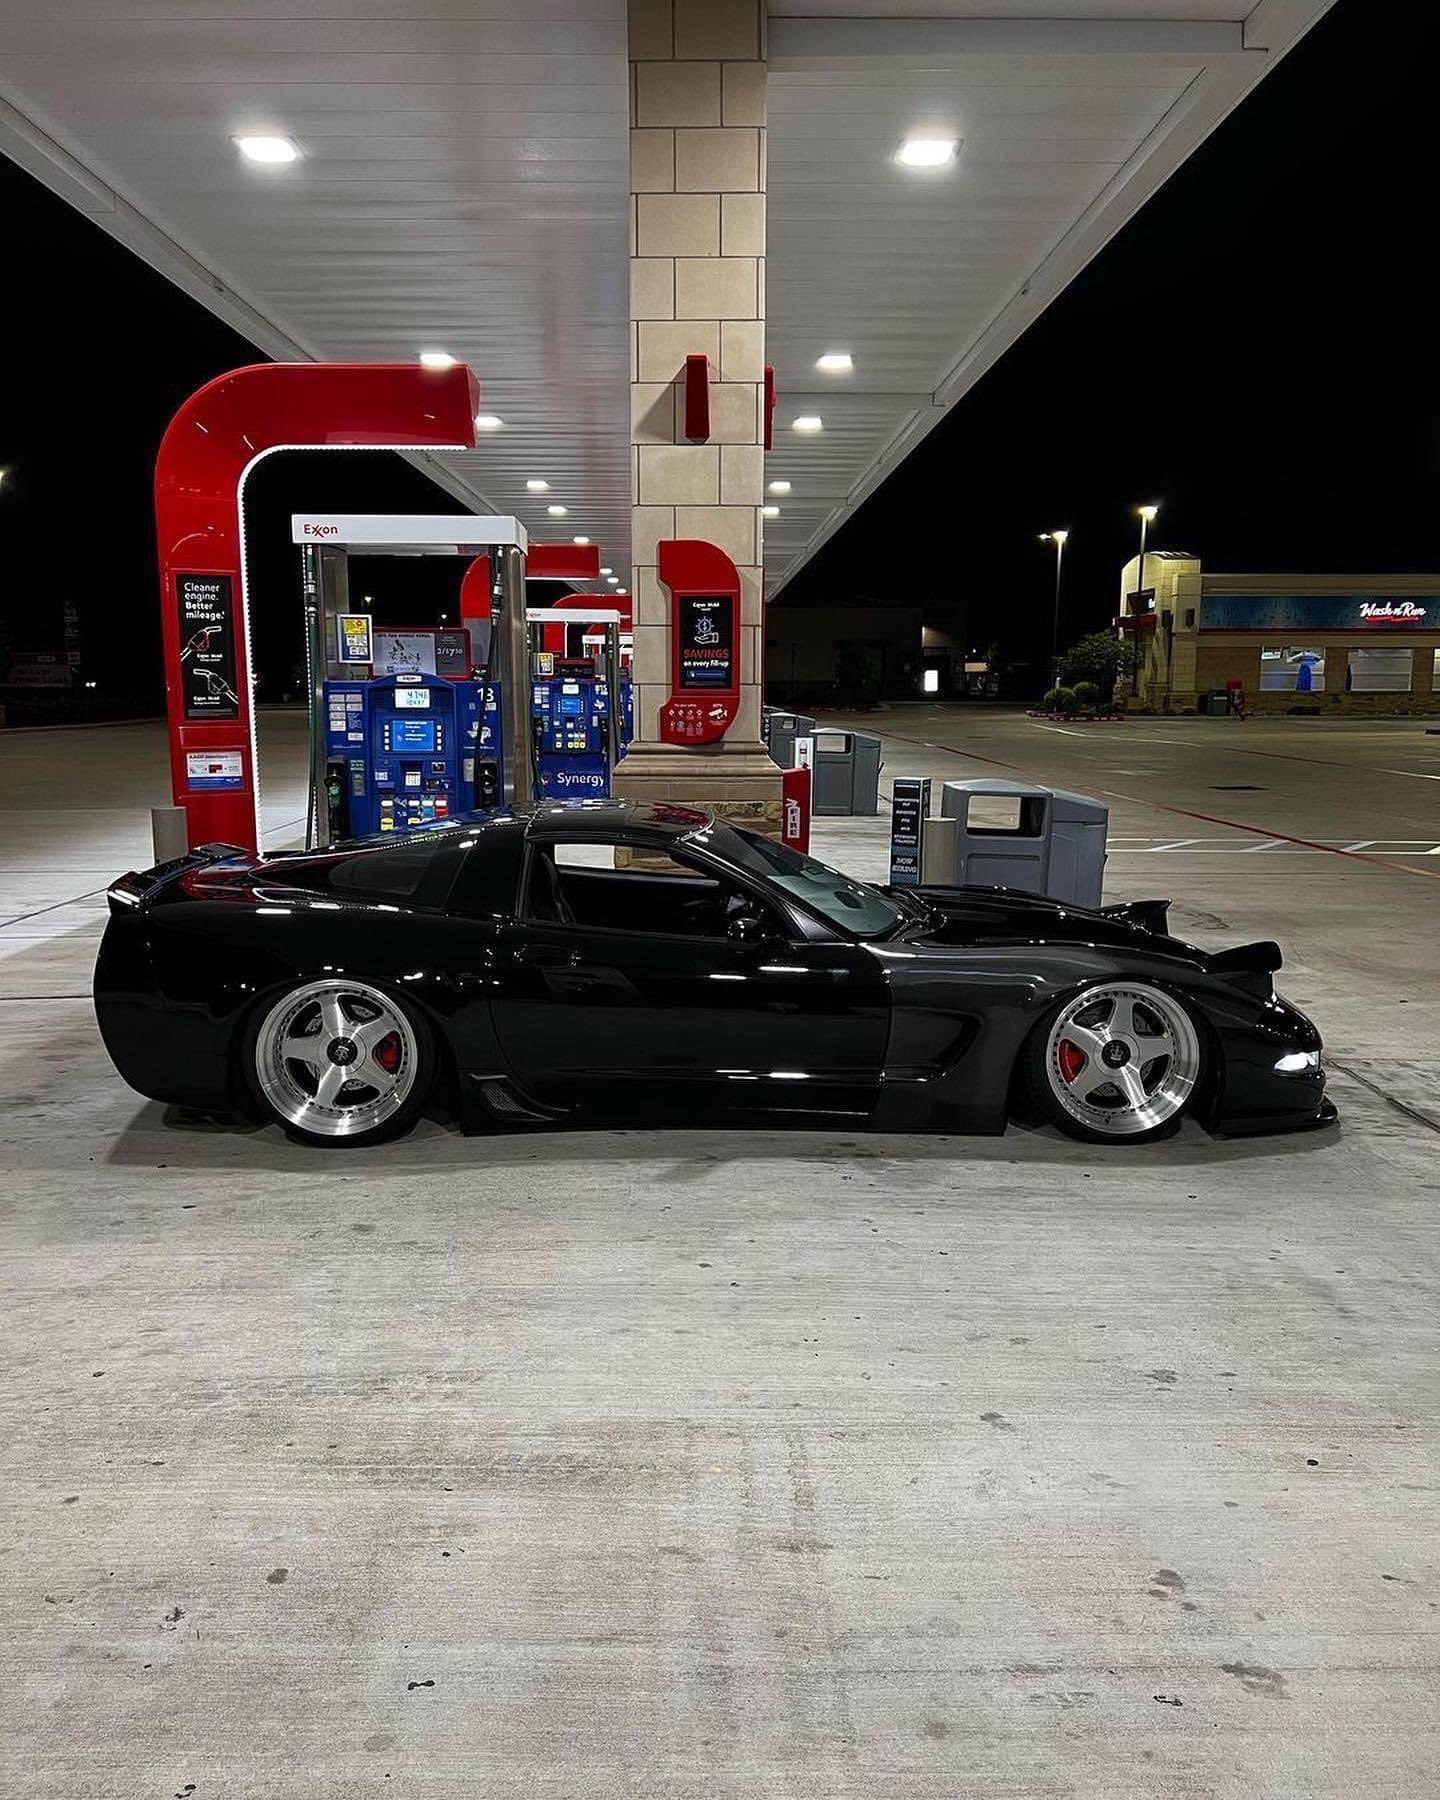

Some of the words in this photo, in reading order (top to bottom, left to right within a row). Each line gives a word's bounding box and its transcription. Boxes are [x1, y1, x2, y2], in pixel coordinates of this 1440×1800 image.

[304, 523, 338, 537] Exxon
[184, 582, 220, 592] Cleaner
[185, 592, 219, 602] engine.
[185, 601, 213, 610] Better
[1360, 602, 1392, 617] Wash
[1401, 602, 1426, 616] Run
[684, 649, 729, 659] SAVINGS
[477, 687, 494, 702] 13
[557, 772, 604, 787] Synergy
